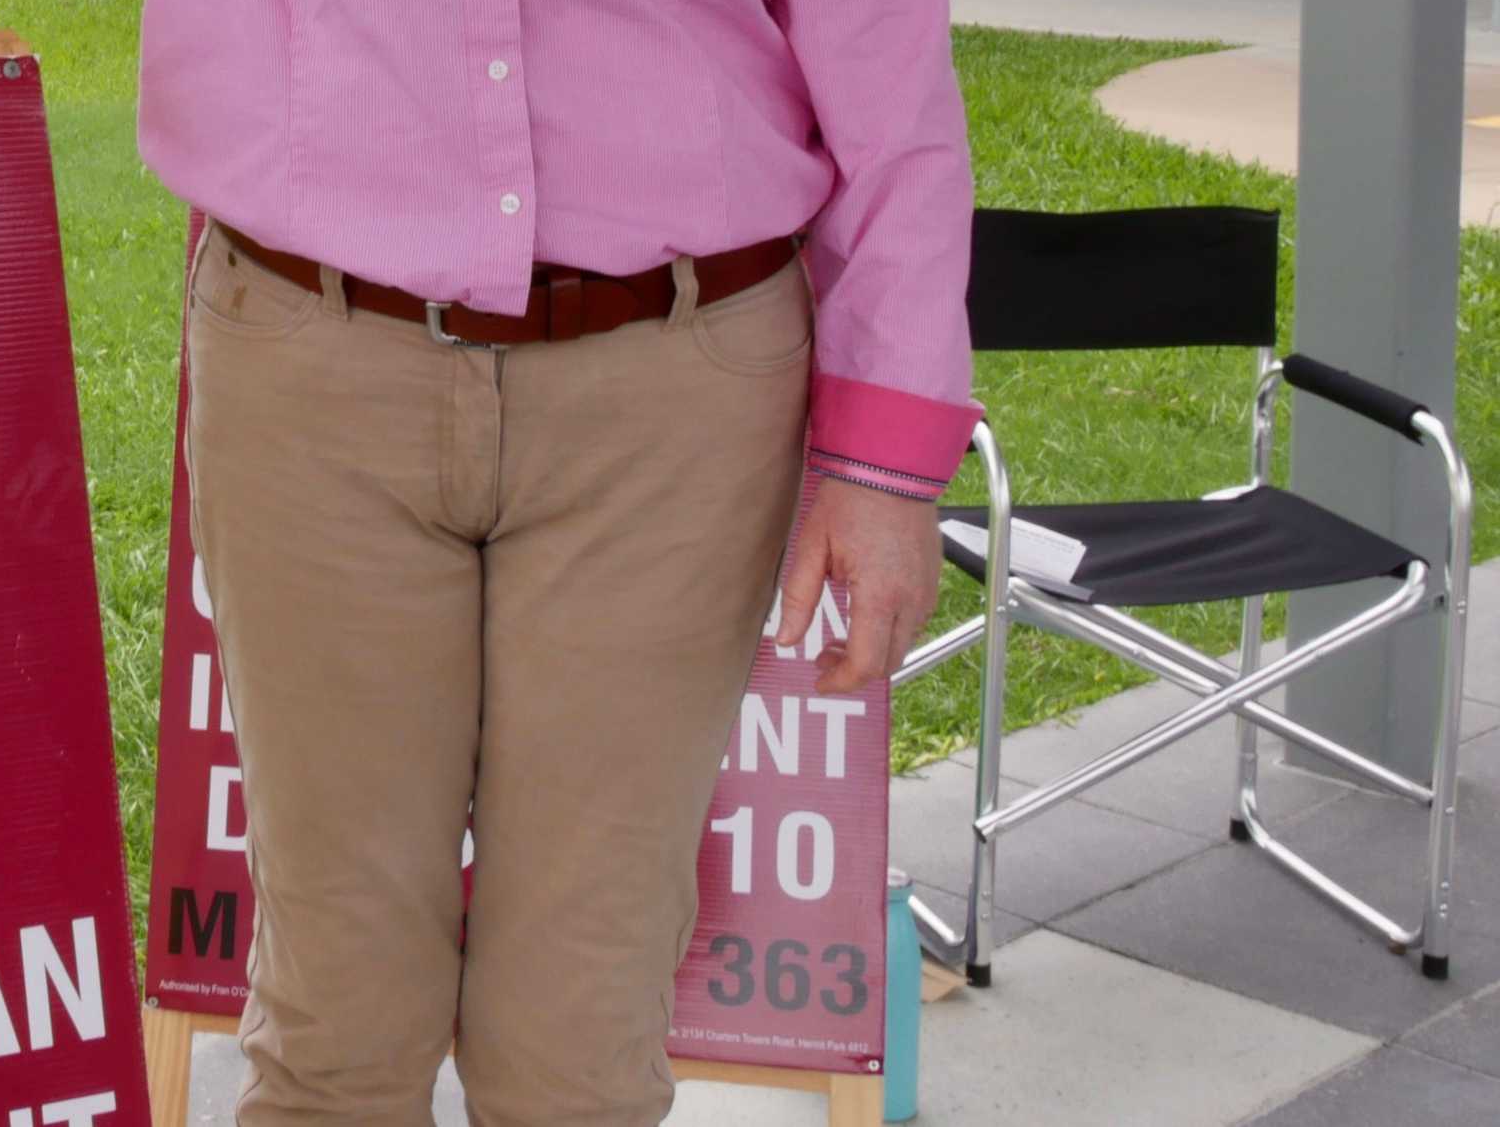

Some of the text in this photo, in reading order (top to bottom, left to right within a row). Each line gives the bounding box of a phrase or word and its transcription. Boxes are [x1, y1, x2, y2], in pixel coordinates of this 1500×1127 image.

[711, 806, 835, 901] 10
[200, 983, 210, 996] by
[707, 934, 869, 1016] 363
